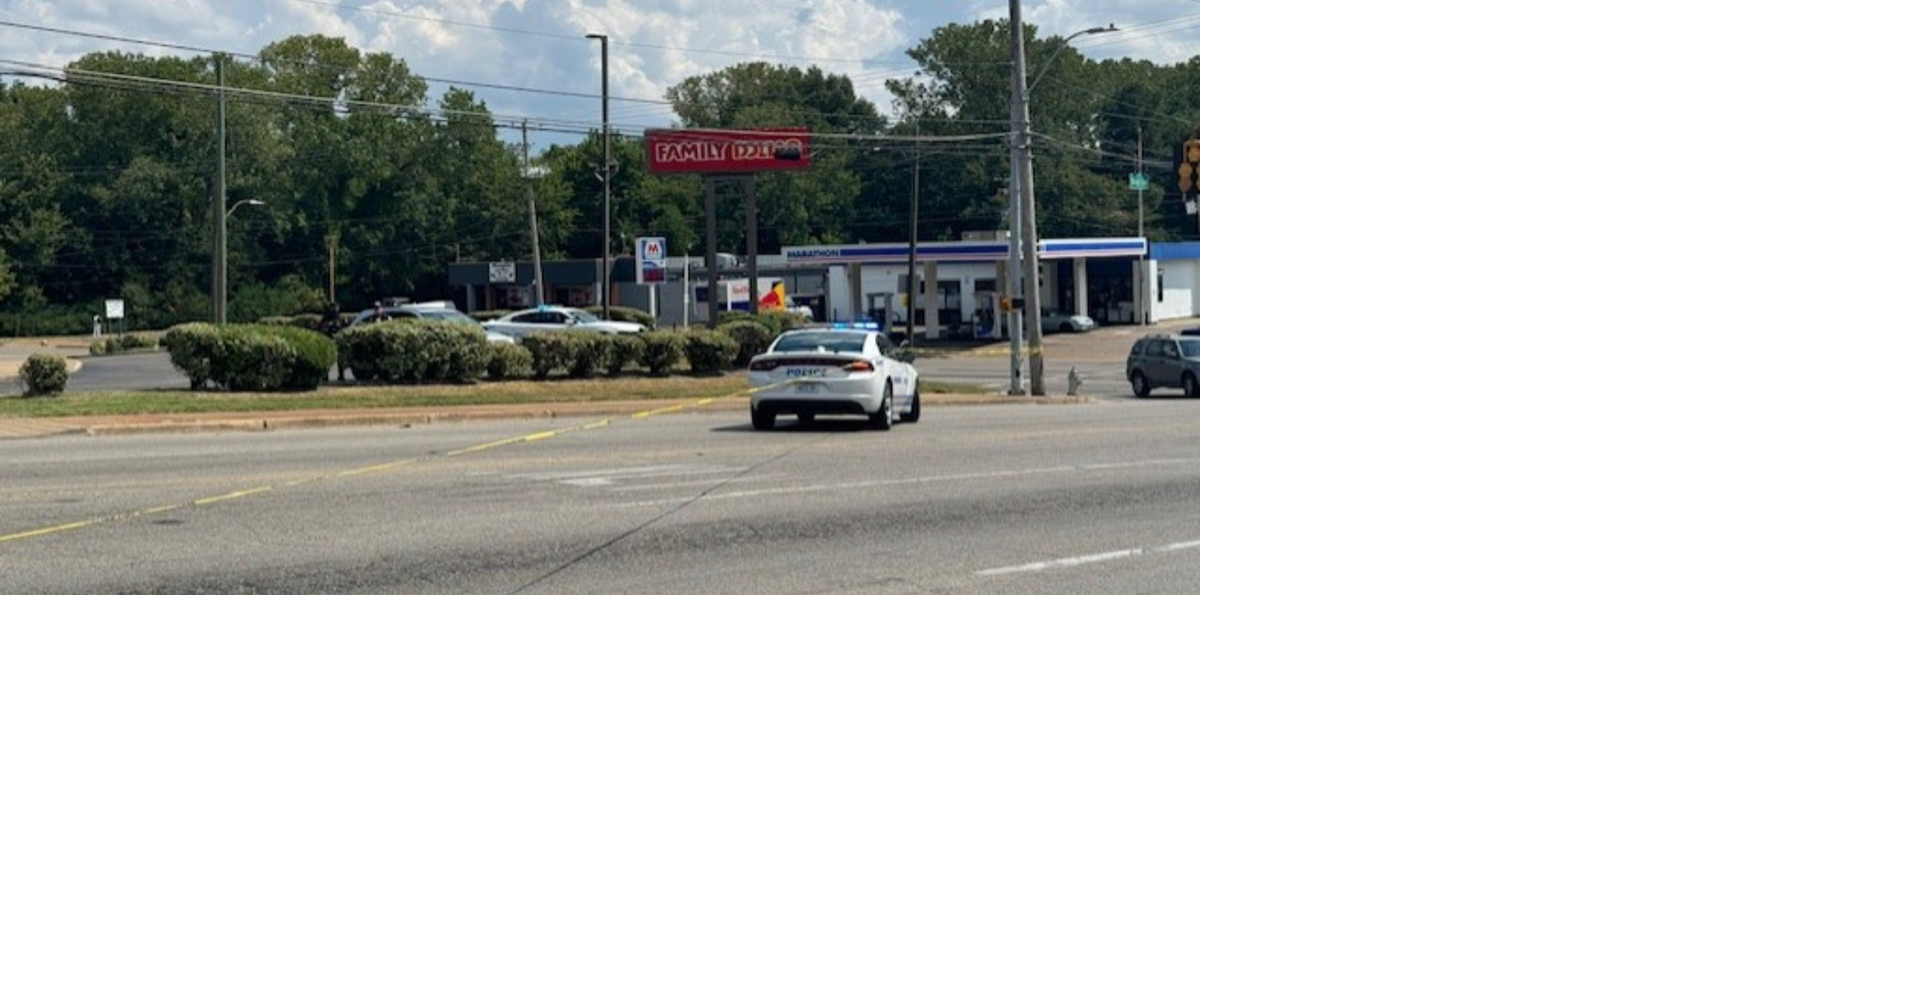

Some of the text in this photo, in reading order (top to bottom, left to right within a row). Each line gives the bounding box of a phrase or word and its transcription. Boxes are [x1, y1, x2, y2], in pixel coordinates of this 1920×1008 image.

[656, 141, 726, 162] FAMILY
[787, 249, 839, 258] MARATHON
[786, 367, 827, 378] POLICE
